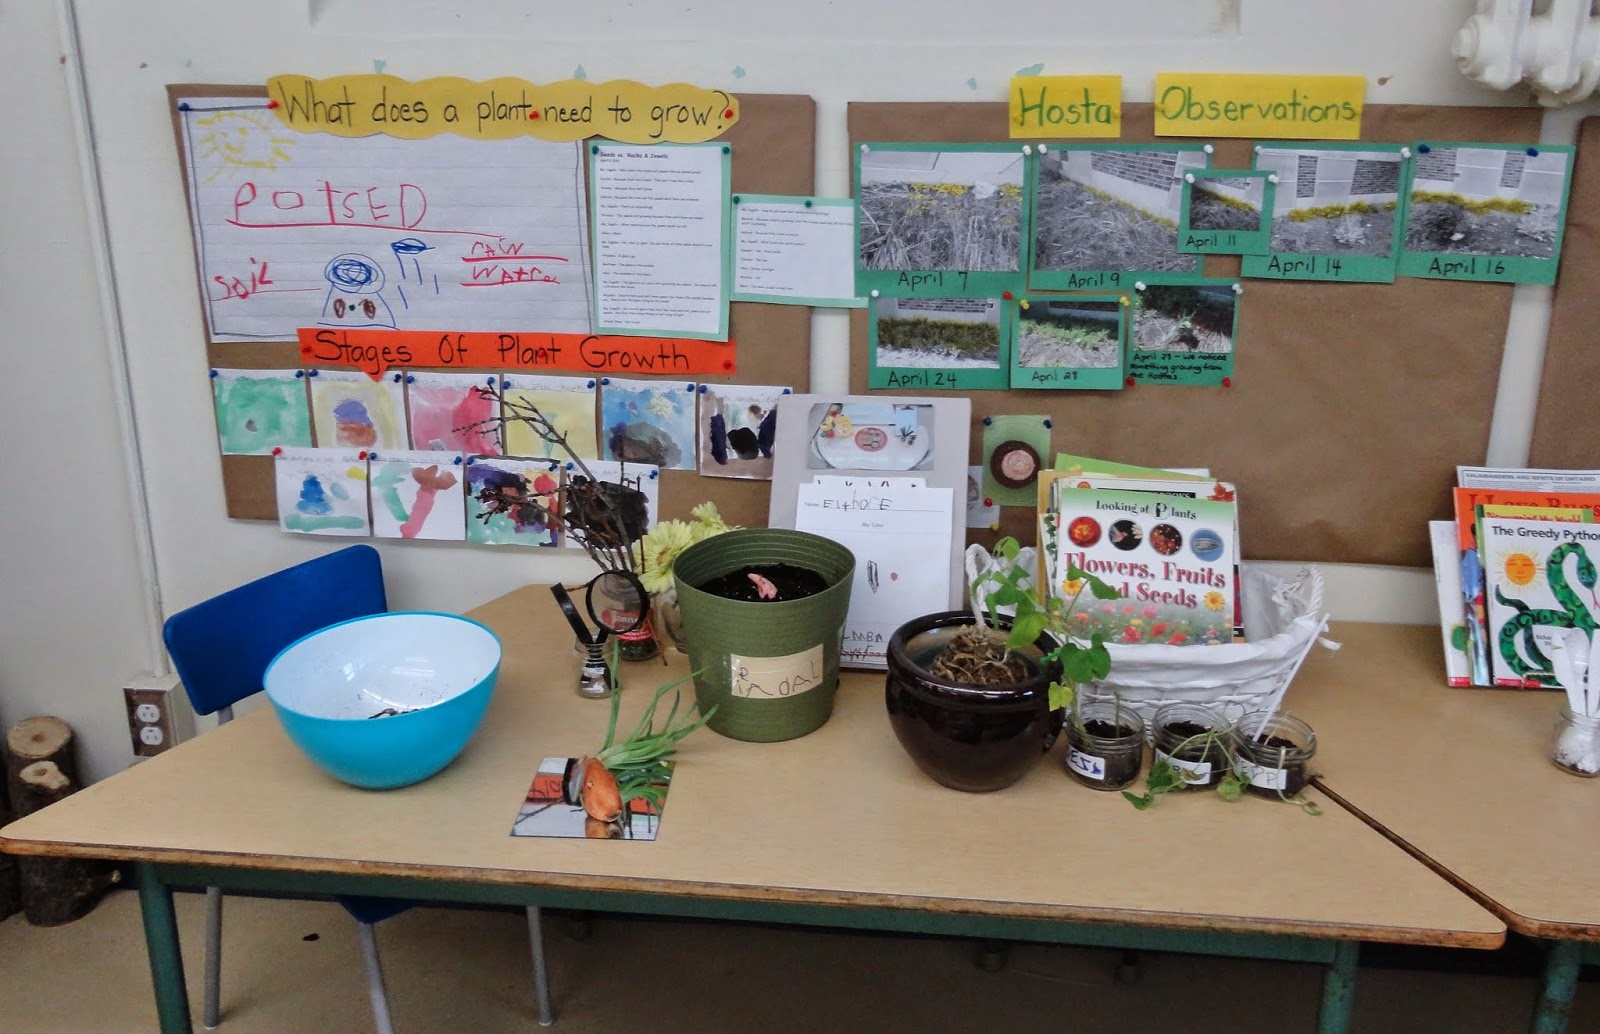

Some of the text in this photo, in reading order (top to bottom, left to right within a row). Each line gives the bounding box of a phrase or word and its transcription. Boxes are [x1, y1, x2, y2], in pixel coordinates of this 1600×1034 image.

[278, 80, 730, 139] What does a plant need to grow?
[1019, 86, 1113, 127] Hosta
[1161, 86, 1357, 123] Observations
[1186, 234, 1236, 249] April 11
[1267, 255, 1342, 276] April 14
[1429, 256, 1505, 276] April 16
[898, 271, 968, 292] April 7
[1068, 272, 1120, 289] April 9
[314, 330, 690, 375] Stages Of Plant Growth
[1134, 353, 1157, 362] April
[1031, 371, 1058, 384] April
[1129, 363, 1222, 374] something growing from
[887, 371, 957, 388] April 24
[1466, 472, 1515, 480] SALAMANDERS
[1096, 500, 1139, 516] Looking
[1140, 504, 1150, 513] at
[1491, 525, 1600, 541] The Greedy Pytho
[1161, 561, 1226, 588] Fruits
[1136, 582, 1198, 608] Seeds
